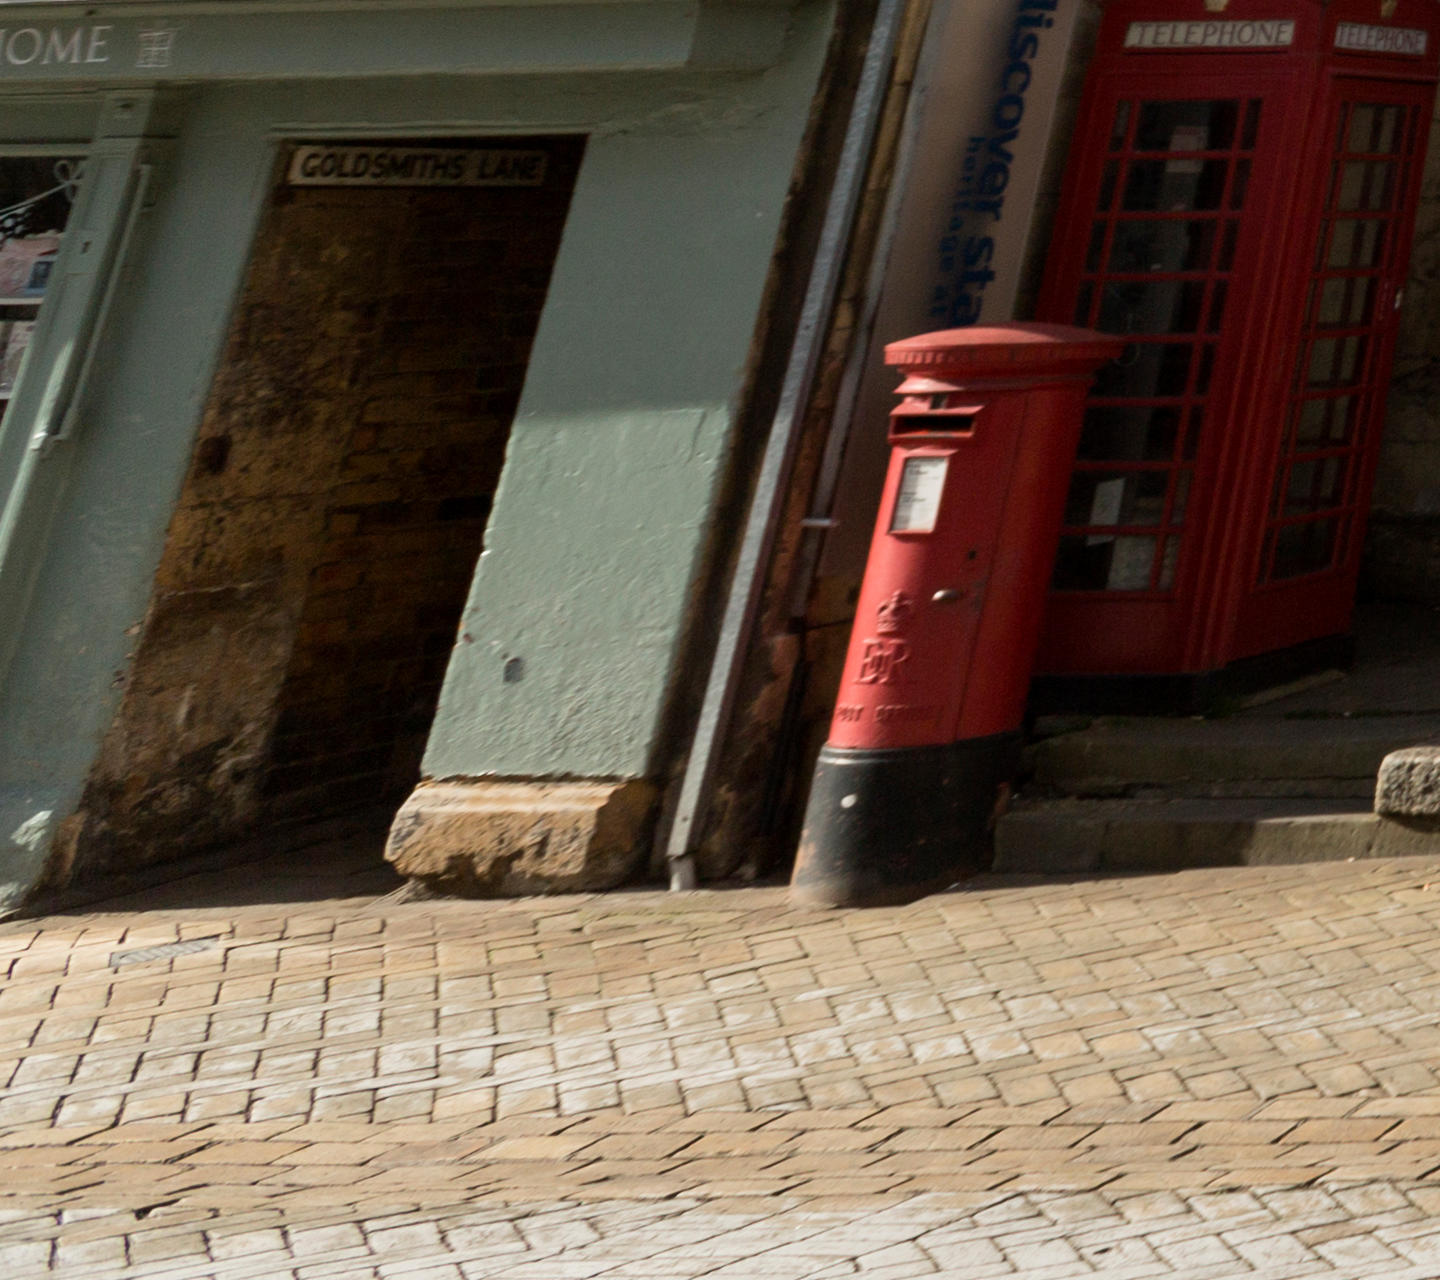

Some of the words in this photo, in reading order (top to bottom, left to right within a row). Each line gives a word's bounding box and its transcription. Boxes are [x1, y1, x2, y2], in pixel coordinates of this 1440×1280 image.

[1135, 20, 1289, 47] TELEPHONE
[1337, 22, 1423, 53] TELEPHONE
[301, 152, 467, 179] GOLDSMITHS
[477, 153, 544, 181] LANE
[951, 236, 996, 327] sta
